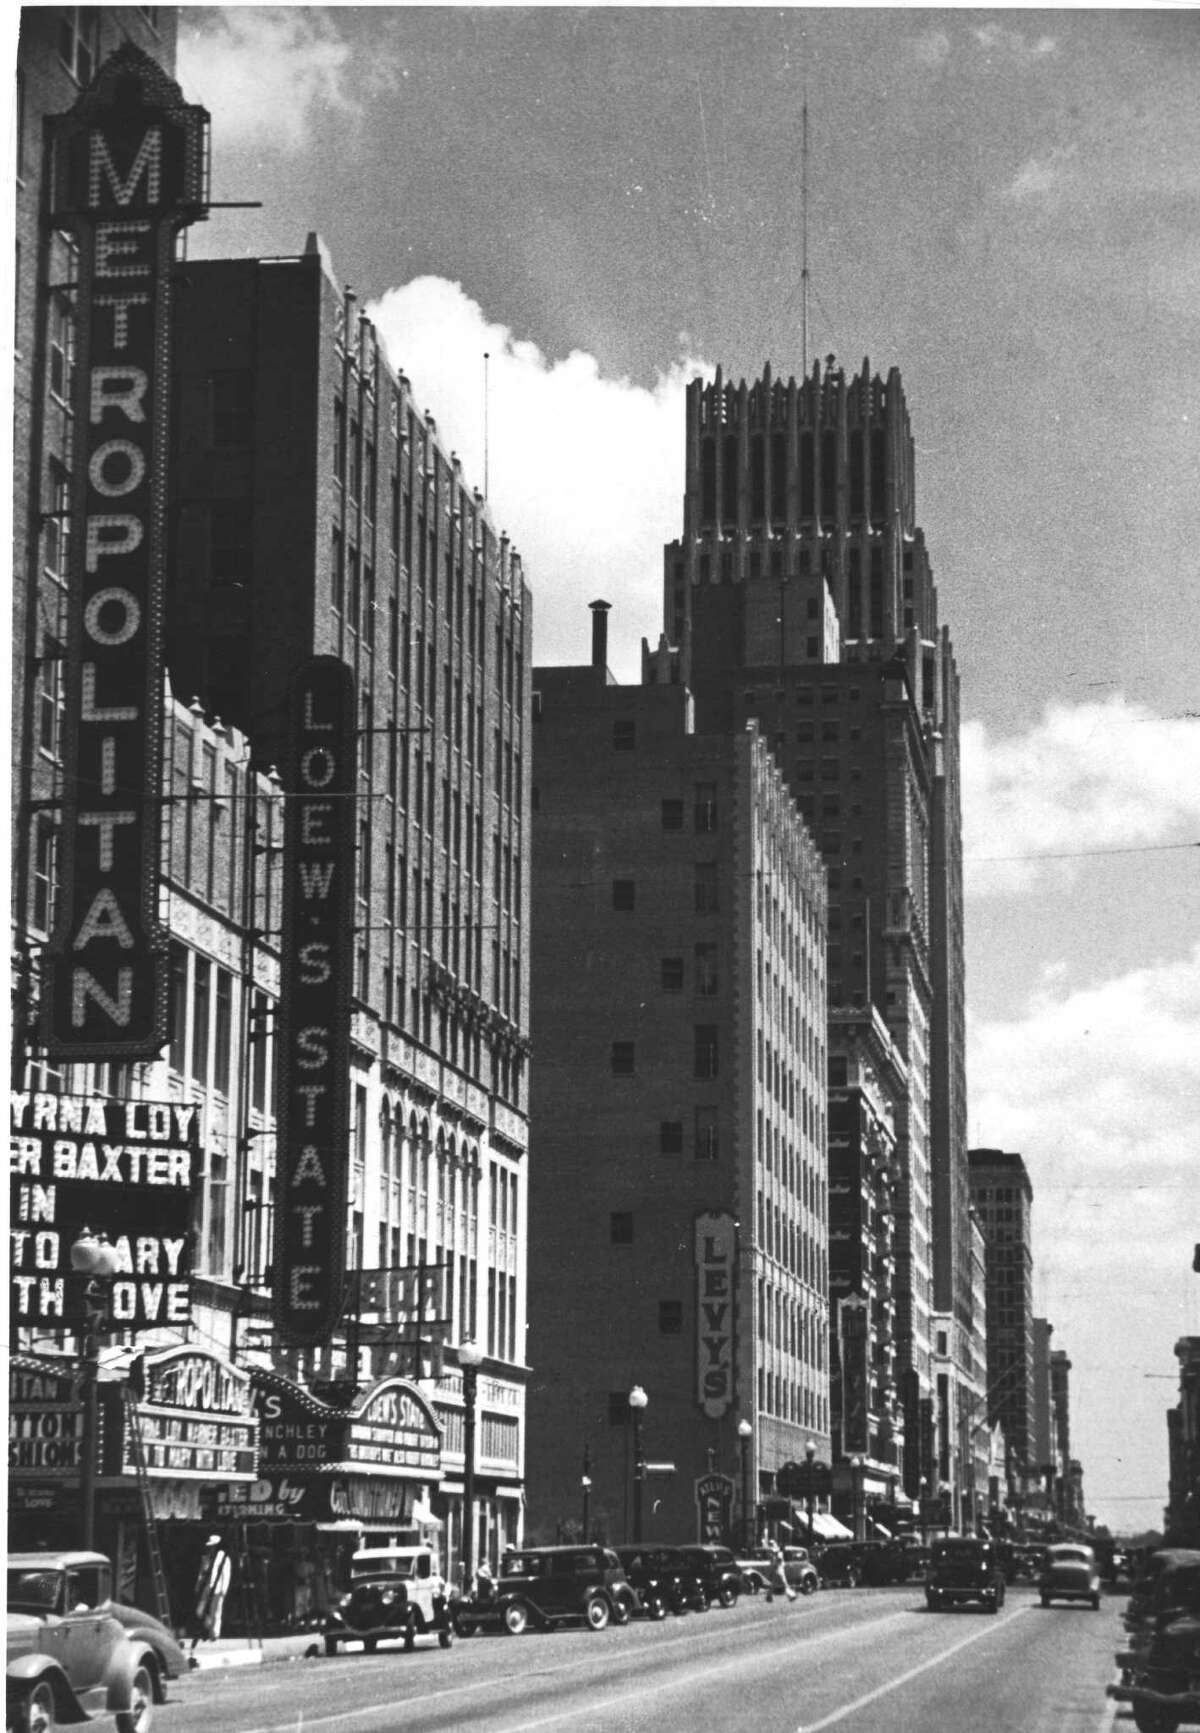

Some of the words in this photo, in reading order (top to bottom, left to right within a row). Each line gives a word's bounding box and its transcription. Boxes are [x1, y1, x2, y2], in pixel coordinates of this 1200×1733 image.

[70, 126, 162, 1029] METROPOLITAN
[10, 1090, 108, 1136] YRNA
[125, 1102, 195, 1142] LOY
[53, 1139, 191, 1187] BAXTER
[290, 1026, 329, 1310] STATE
[19, 1183, 56, 1223] IN
[10, 1228, 60, 1270] TO
[112, 1235, 185, 1275] ARY
[12, 1276, 65, 1317] TH
[113, 1281, 190, 1321] OVE
[296, 1444, 327, 1460] DOG
